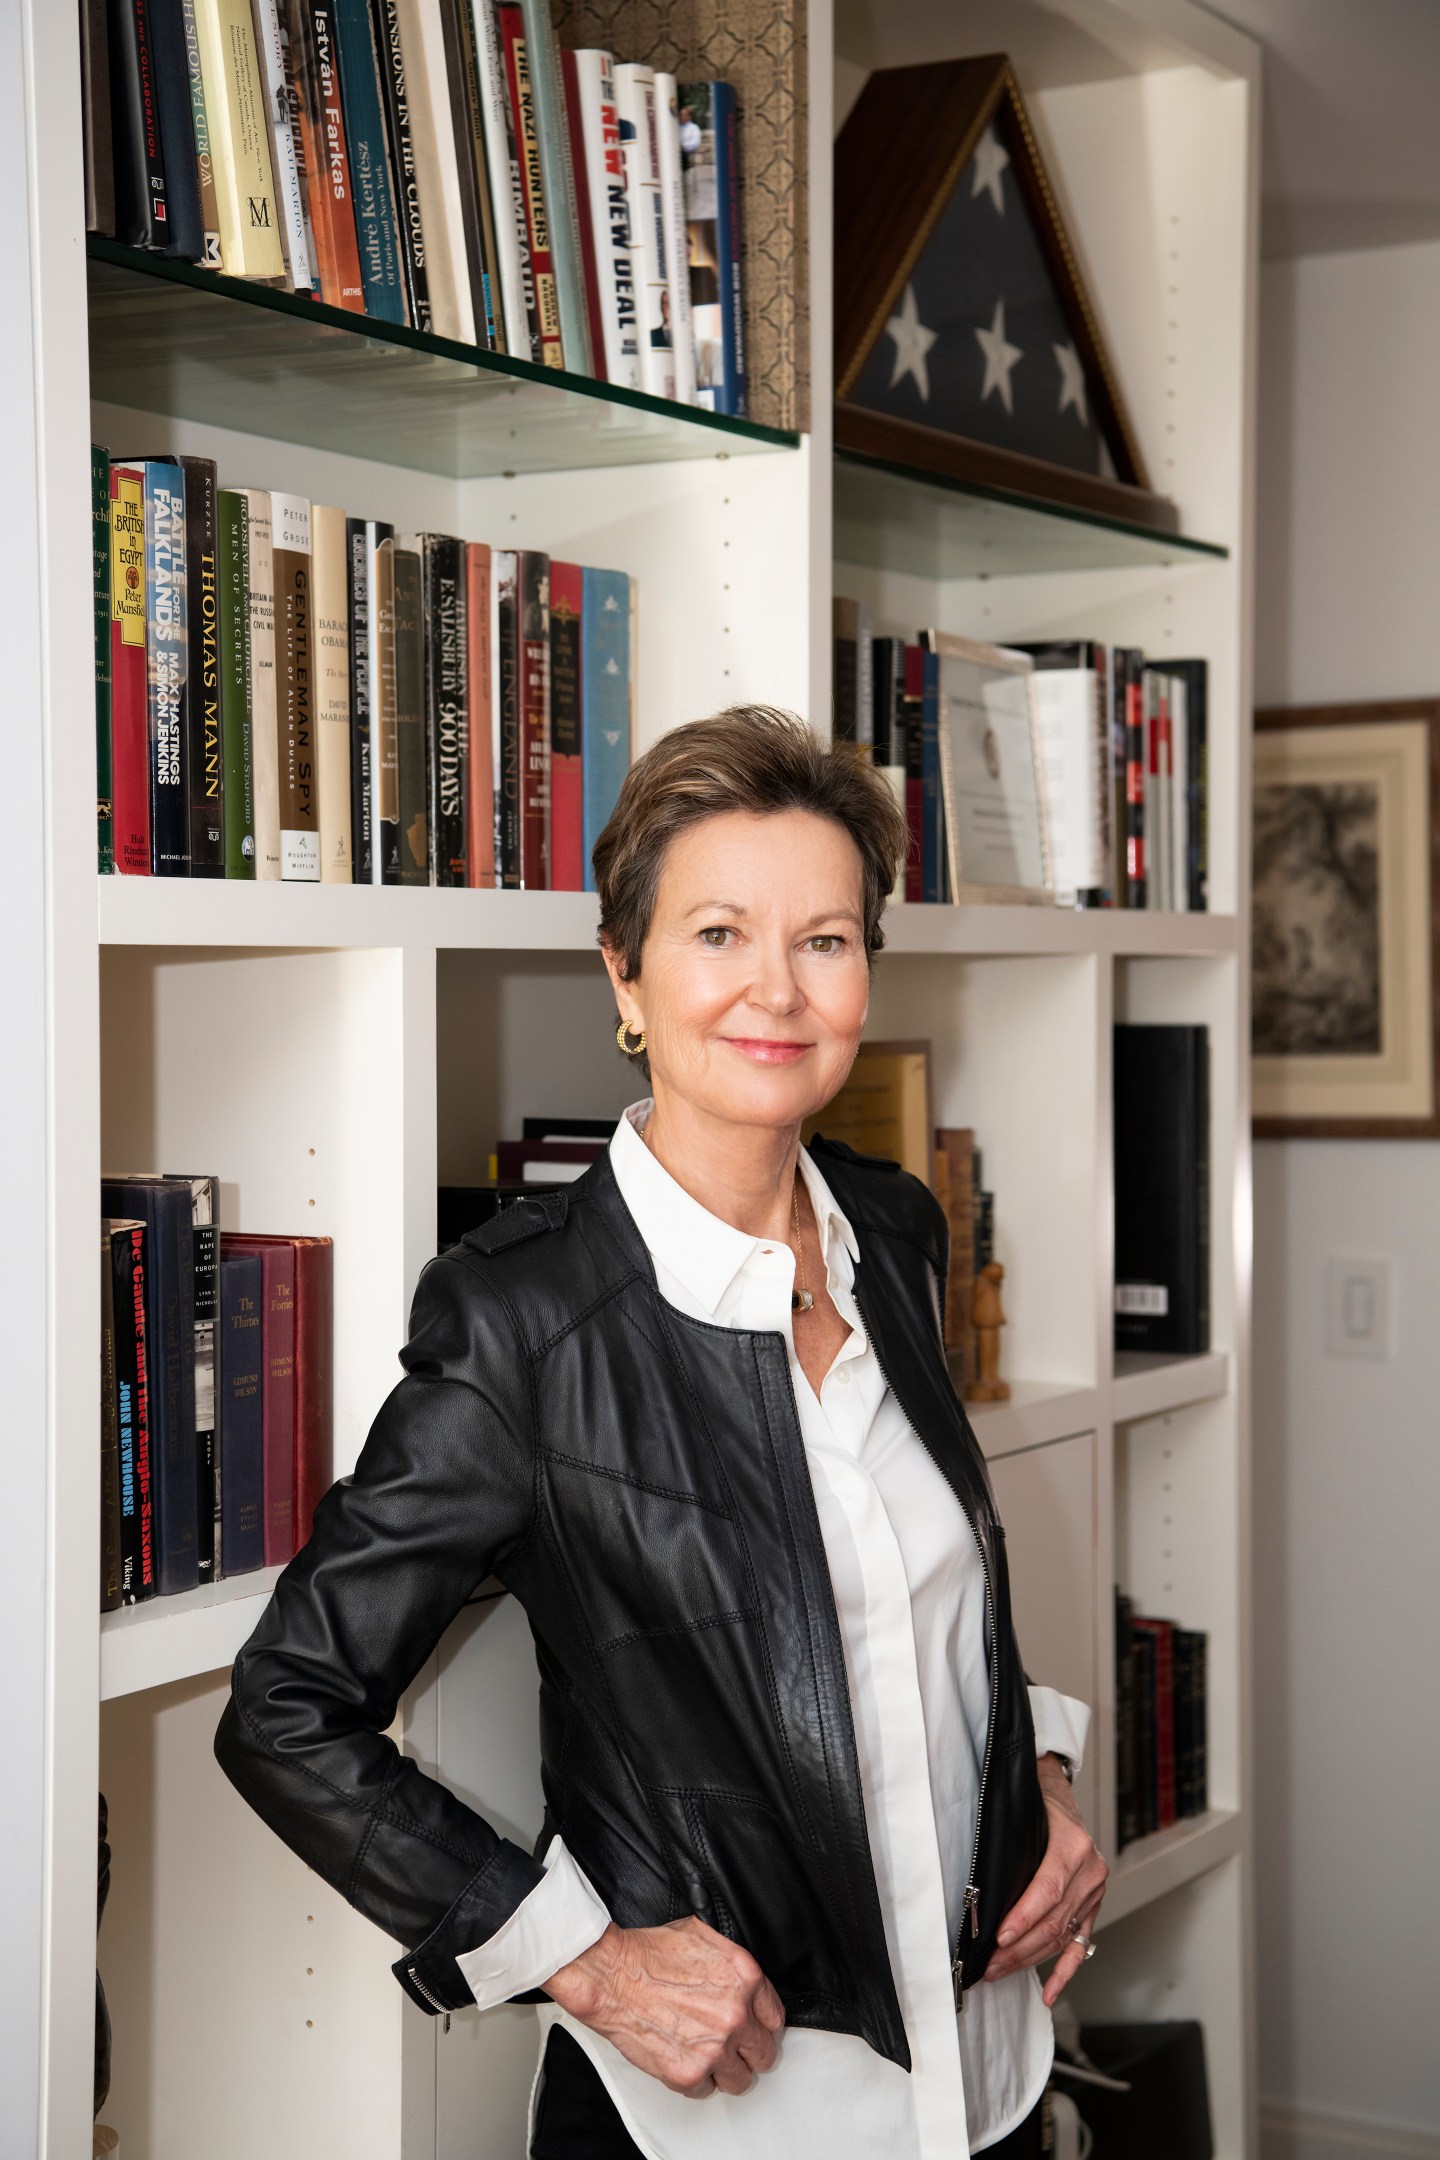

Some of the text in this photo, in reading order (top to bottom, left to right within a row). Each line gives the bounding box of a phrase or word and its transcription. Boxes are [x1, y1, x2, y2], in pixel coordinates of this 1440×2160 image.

[137, 20, 146, 42] AND
[272, 22, 283, 69] STORY
[140, 46, 156, 157] COLLABORATION
[186, 24, 213, 187] WORLD FAMOUS
[314, 10, 345, 200] István Farkas
[397, 103, 410, 126] IN
[402, 137, 416, 176] THE
[516, 44, 548, 247] THE NAZI HUNTERS
[601, 104, 623, 176] NEW
[285, 134, 295, 170] KATI
[291, 175, 304, 238] MARTON
[375, 164, 384, 190] York
[356, 141, 384, 287] André Kertész
[379, 195, 387, 217] New
[607, 183, 629, 250] NEW
[381, 220, 391, 240] and
[406, 187, 426, 269] CLOUDS
[386, 243, 395, 270] Paris
[342, 286, 362, 297] ARTHIS
[613, 257, 637, 330] DEAL
[731, 262, 743, 374] BOB WOODWARD
[115, 514, 145, 535] BRITISH
[124, 501, 138, 517] THE
[204, 477, 212, 538] KURZKE
[283, 508, 308, 523] PETER
[129, 532, 137, 550] in
[283, 531, 309, 546] GROSE
[119, 548, 143, 567] EGYPT
[153, 488, 173, 642] FALKLANDS
[170, 497, 185, 640] BATTLE FOR THE
[124, 588, 141, 603] Peter
[231, 524, 243, 684] MEN OF SECRETS
[250, 606, 259, 616] THE
[253, 620, 266, 630] CIVIL
[352, 533, 370, 715] ENEMIES OF THE PEOPLE
[440, 595, 457, 695] SALISBURY
[201, 551, 219, 799] THOMAS MANN
[287, 666, 293, 680] OF
[295, 569, 311, 817] GENTLEMAN SPY
[156, 651, 169, 785] & SIMON JENKINS
[168, 653, 180, 785] MAX HASTINGS
[503, 658, 517, 800] ENGLAND
[242, 722, 250, 762] DAVID
[438, 702, 460, 817] 900 DAYS
[243, 764, 251, 824] STAFFORD
[362, 743, 371, 841] Kati Marton
[131, 834, 145, 845] Holt
[287, 851, 317, 859] HOUGHTON
[292, 862, 314, 870] MIFFLIN
[195, 1264, 218, 1272] EUROPA
[239, 1297, 254, 1311] The
[271, 1298, 294, 1311] Forties
[276, 1284, 290, 1296] The
[231, 1313, 259, 1329] Thirties
[271, 1356, 293, 1367] EDMUND
[271, 1368, 292, 1377] WILSON
[233, 1374, 258, 1386] EDMUND
[234, 1386, 257, 1397] WILSON
[131, 1229, 152, 1585] De Gaulle and the Anglo-Saxons
[118, 1380, 135, 1516] JOHN NEWHOUSE
[122, 1555, 133, 1589] Viking
